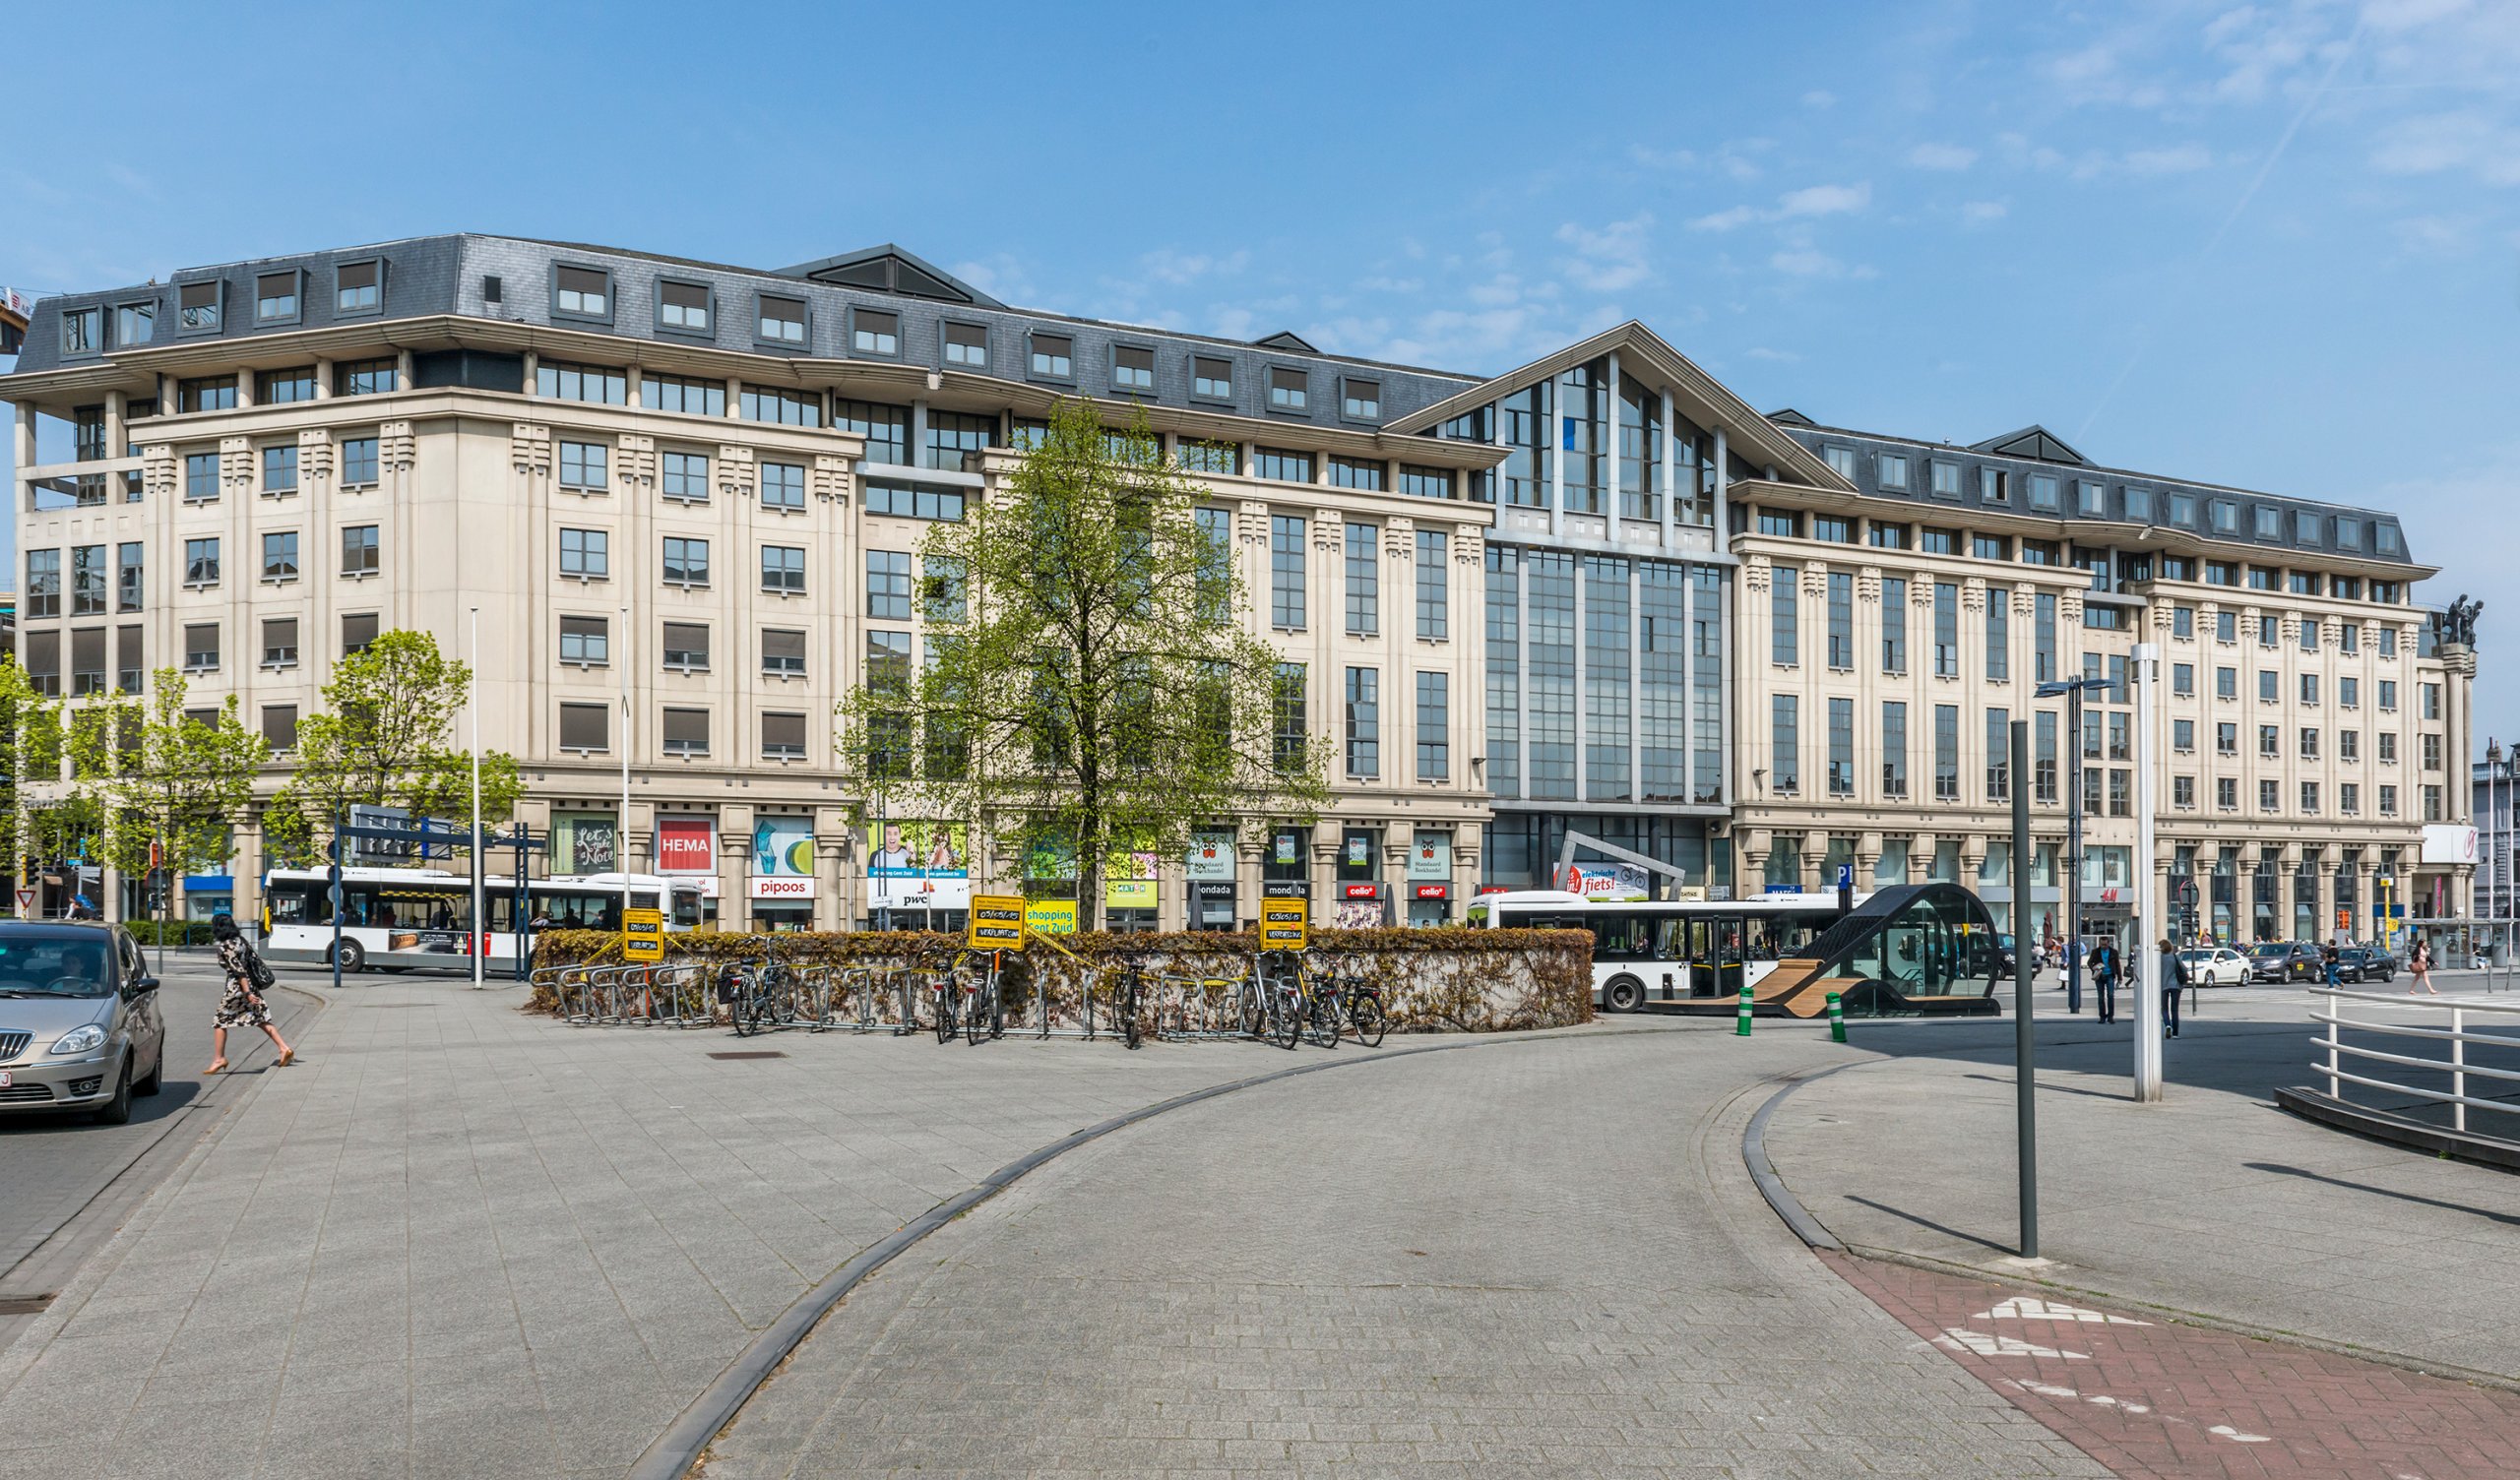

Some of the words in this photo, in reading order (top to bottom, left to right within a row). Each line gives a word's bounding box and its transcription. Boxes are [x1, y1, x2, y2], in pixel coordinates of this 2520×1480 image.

[577, 825, 612, 851] Let's
[662, 838, 709, 852] HEMA
[1582, 869, 1616, 879] elektrische
[1838, 866, 1847, 884] P
[761, 880, 806, 895] pipoos
[1200, 885, 1230, 894] ondada
[1269, 886, 1306, 894] monda
[1583, 877, 1615, 895] fiets!
[904, 895, 928, 906] pwc
[1027, 909, 1073, 922] shopping
[1050, 922, 1073, 933] Zuid
